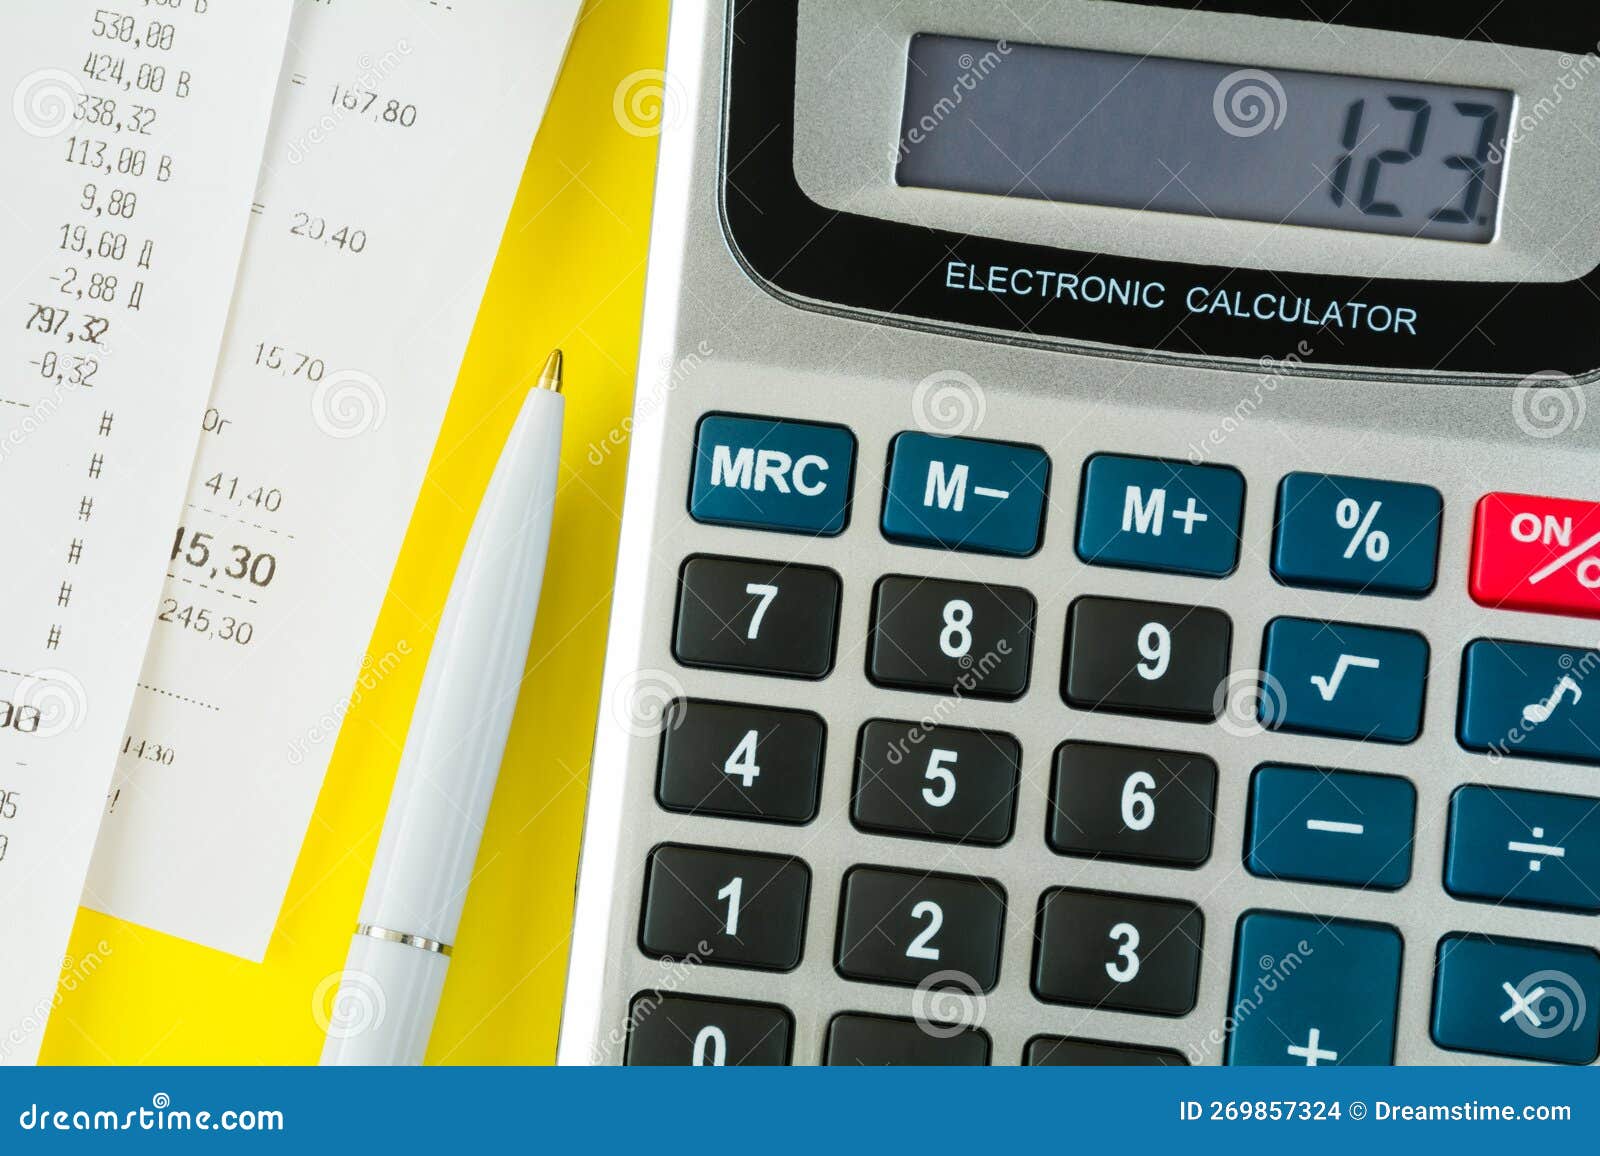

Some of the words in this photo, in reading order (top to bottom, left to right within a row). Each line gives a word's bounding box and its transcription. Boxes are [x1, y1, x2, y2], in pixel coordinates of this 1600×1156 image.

[92, 9, 175, 50] 530,00
[83, 51, 166, 92] 424,00
[73, 93, 157, 135] 338,32
[332, 84, 417, 128] 167,80
[65, 136, 146, 177] 113,00
[80, 184, 137, 219] 9,80
[60, 224, 127, 260] 19,60
[290, 212, 367, 253] 20,40
[50, 267, 118, 302] -2,88
[946, 262, 1165, 308] ELECTRONIC
[1186, 287, 1418, 335] CALCULATOR
[25, 302, 110, 345] 797,32
[29, 352, 98, 387] -0,32
[256, 342, 325, 381] 15,70
[204, 472, 282, 512] 41,40
[710, 445, 829, 496] MRC
[1122, 485, 1208, 536] M+
[1335, 498, 1390, 562] %
[158, 598, 253, 645] 245,30
[746, 583, 778, 640] 7
[939, 599, 973, 658] 8
[1137, 622, 1171, 680] 9
[724, 730, 760, 787] 4
[922, 748, 958, 807] 5
[1121, 771, 1156, 831] 6
[718, 877, 742, 935] 1
[906, 901, 943, 960] 2
[1105, 923, 1140, 982] 3
